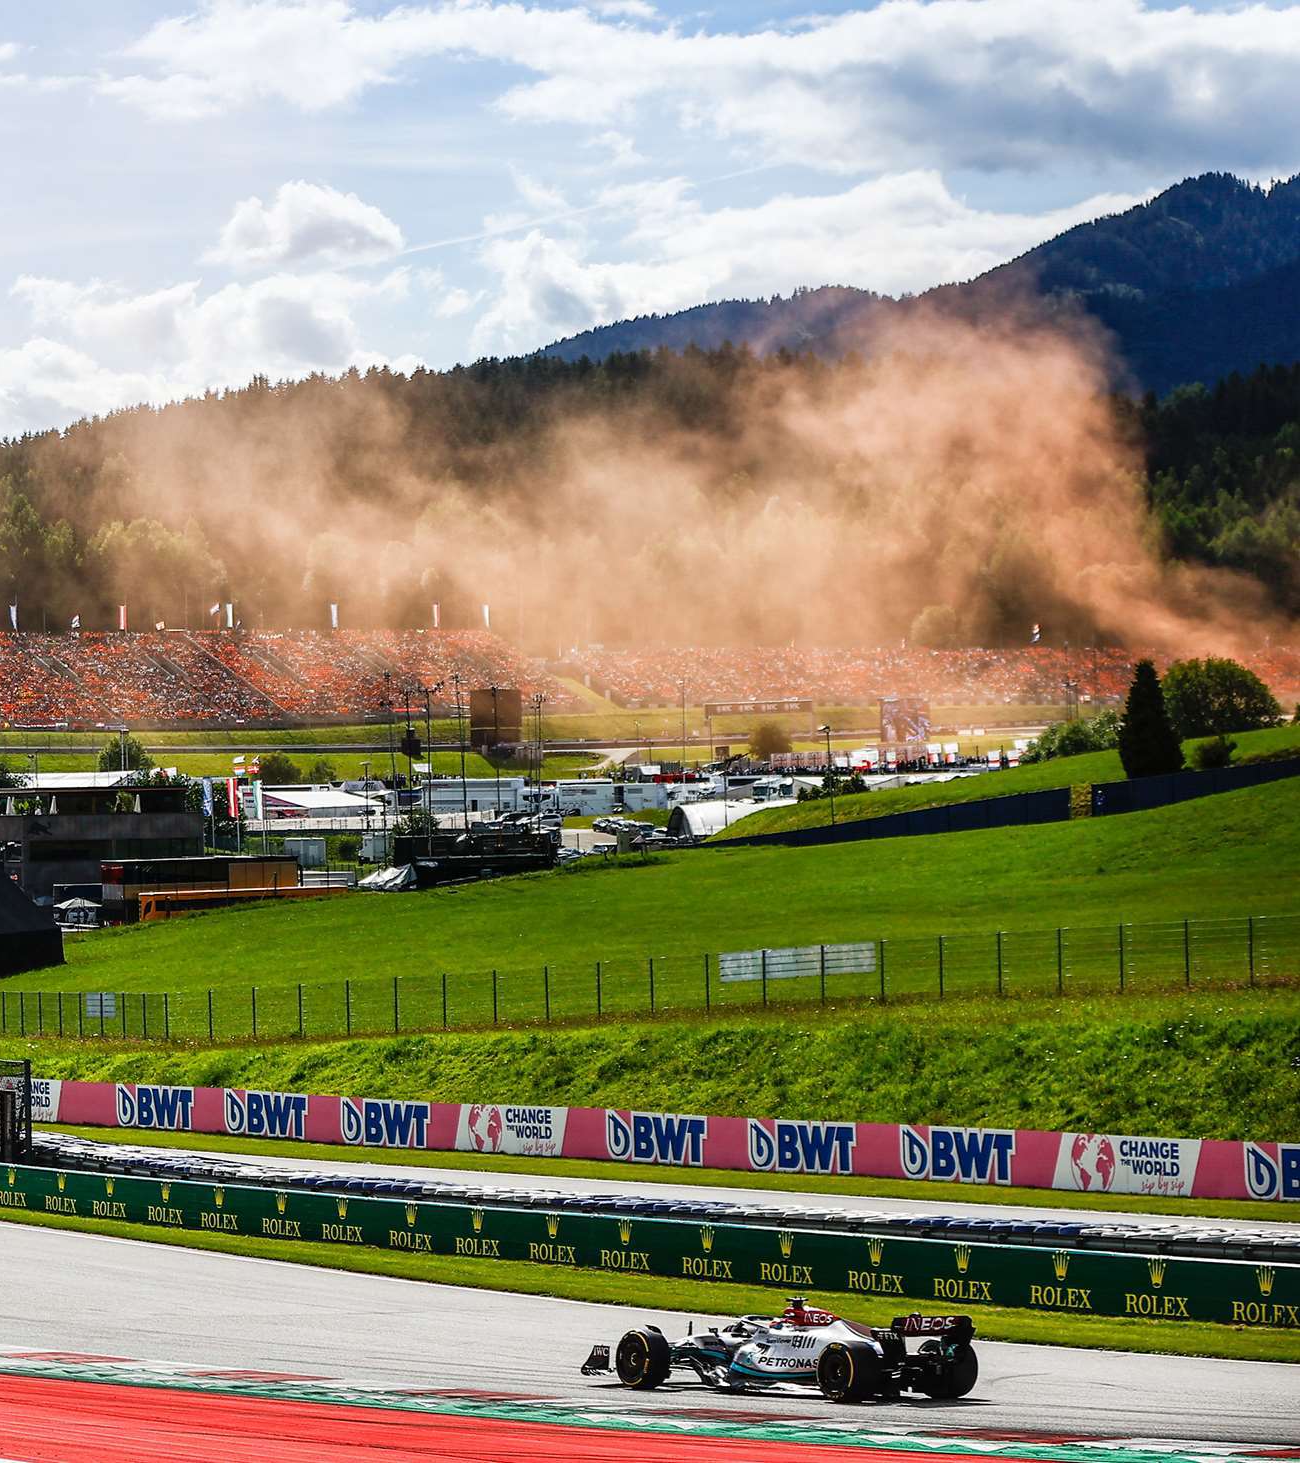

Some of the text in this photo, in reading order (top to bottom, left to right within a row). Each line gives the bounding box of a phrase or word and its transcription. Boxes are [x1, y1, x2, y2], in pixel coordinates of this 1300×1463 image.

[137, 1087, 194, 1129] BWT
[246, 1093, 308, 1138] BWT
[506, 1109, 552, 1124] CHANGE
[364, 1102, 430, 1147] BWT
[515, 1125, 552, 1139] WORLD
[632, 1115, 706, 1165] BWT
[776, 1123, 855, 1174] BWT
[1120, 1140, 1180, 1160] CHANGE
[931, 1129, 1014, 1184] BWT
[1132, 1161, 1180, 1176] WORLD
[1141, 1179, 1154, 1192] sip
[1171, 1178, 1185, 1193] sip
[45, 1195, 77, 1213] ROLEX
[93, 1200, 127, 1218] ROLEX
[148, 1205, 183, 1225] ROLEX
[201, 1212, 238, 1230] ROLEX
[262, 1217, 301, 1237] ROLEX
[322, 1223, 363, 1243] ROLEX
[389, 1230, 433, 1251] ROLEX
[455, 1237, 500, 1257] ROLEX
[529, 1242, 576, 1264] ROLEX
[600, 1250, 650, 1271] ROLEX
[682, 1257, 733, 1279] ROLEX
[760, 1262, 814, 1285] ROLEX
[848, 1270, 904, 1294] ROLEX
[933, 1278, 992, 1300] ROLEX
[1030, 1285, 1093, 1309] ROLEX
[1125, 1294, 1190, 1317] ROLEX
[804, 1312, 834, 1323] INEOS
[1232, 1301, 1300, 1326] ROLEX
[904, 1317, 955, 1331] INEOS
[593, 1346, 609, 1357] IWC
[758, 1357, 818, 1368] PETRONAS
